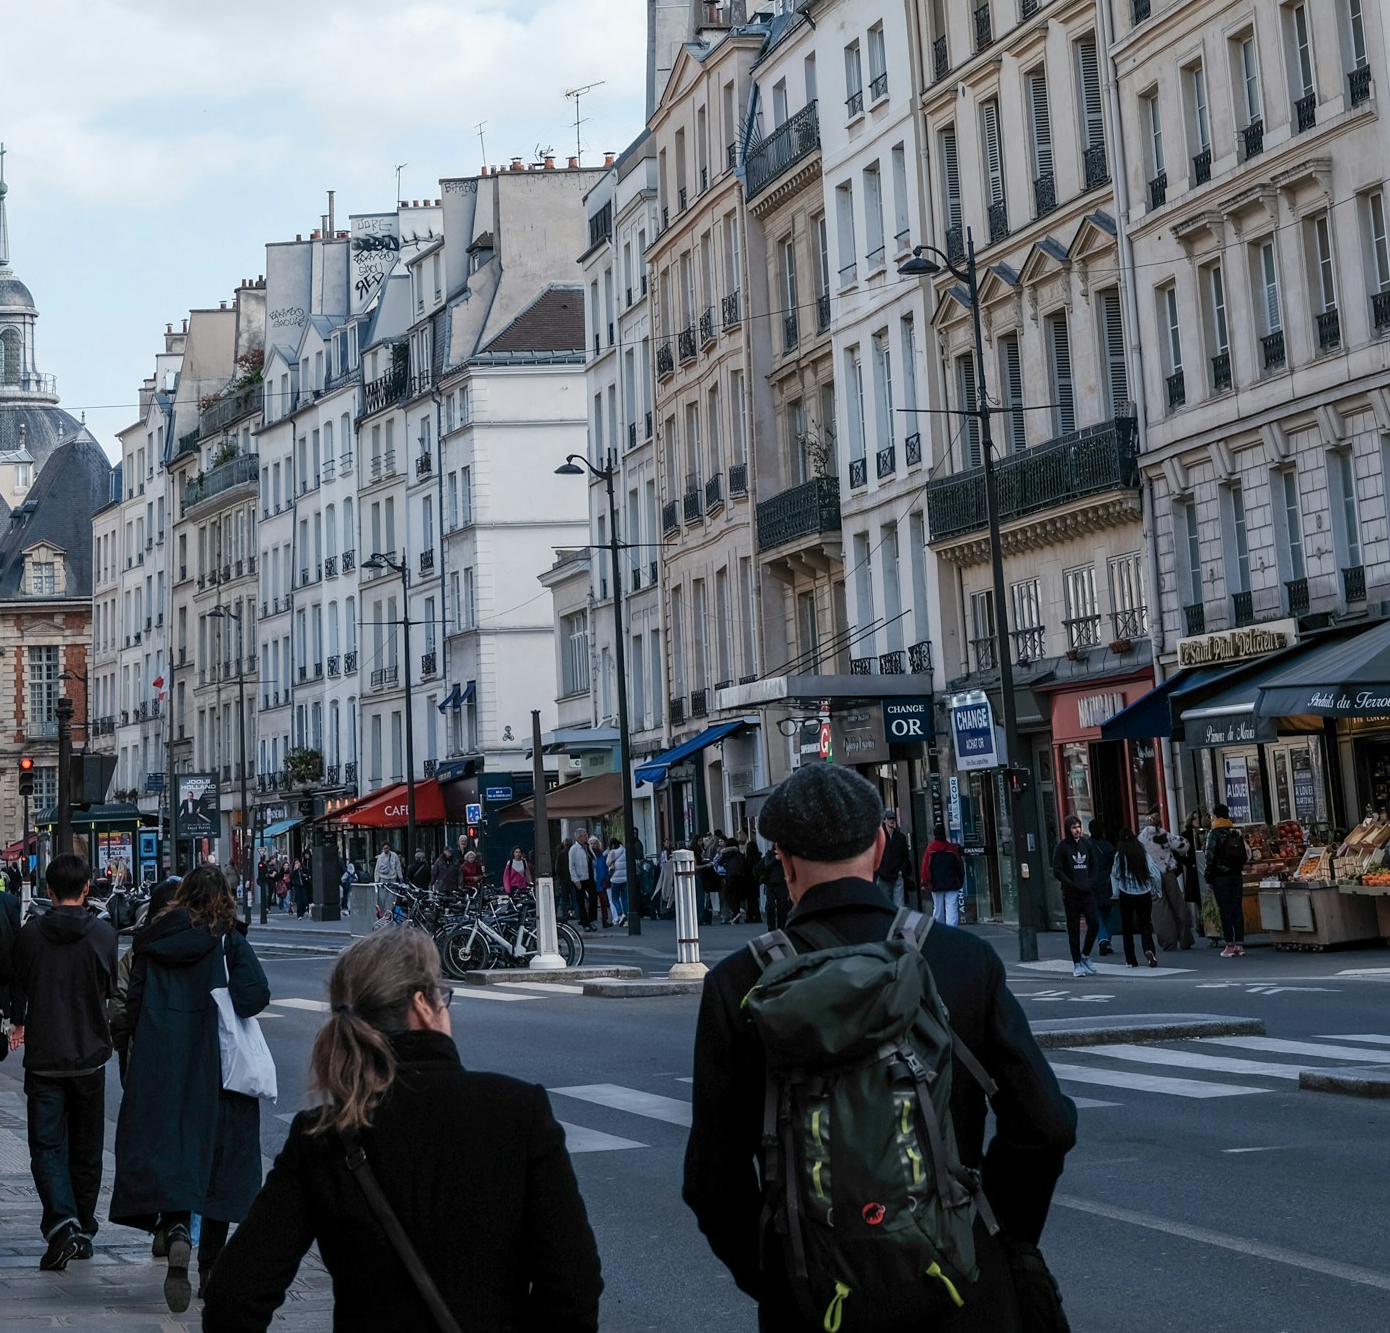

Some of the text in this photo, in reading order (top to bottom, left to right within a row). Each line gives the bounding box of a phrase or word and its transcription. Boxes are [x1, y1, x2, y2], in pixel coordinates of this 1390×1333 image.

[1190, 637, 1212, 664] Saint
[1214, 637, 1235, 660] Paul
[1337, 695, 1351, 708] du
[887, 705, 924, 713] CHANGE
[956, 707, 988, 730] CHANGE
[891, 719, 924, 735] OR
[966, 737, 985, 750] ACHAT OR
[1227, 784, 1233, 798] A
